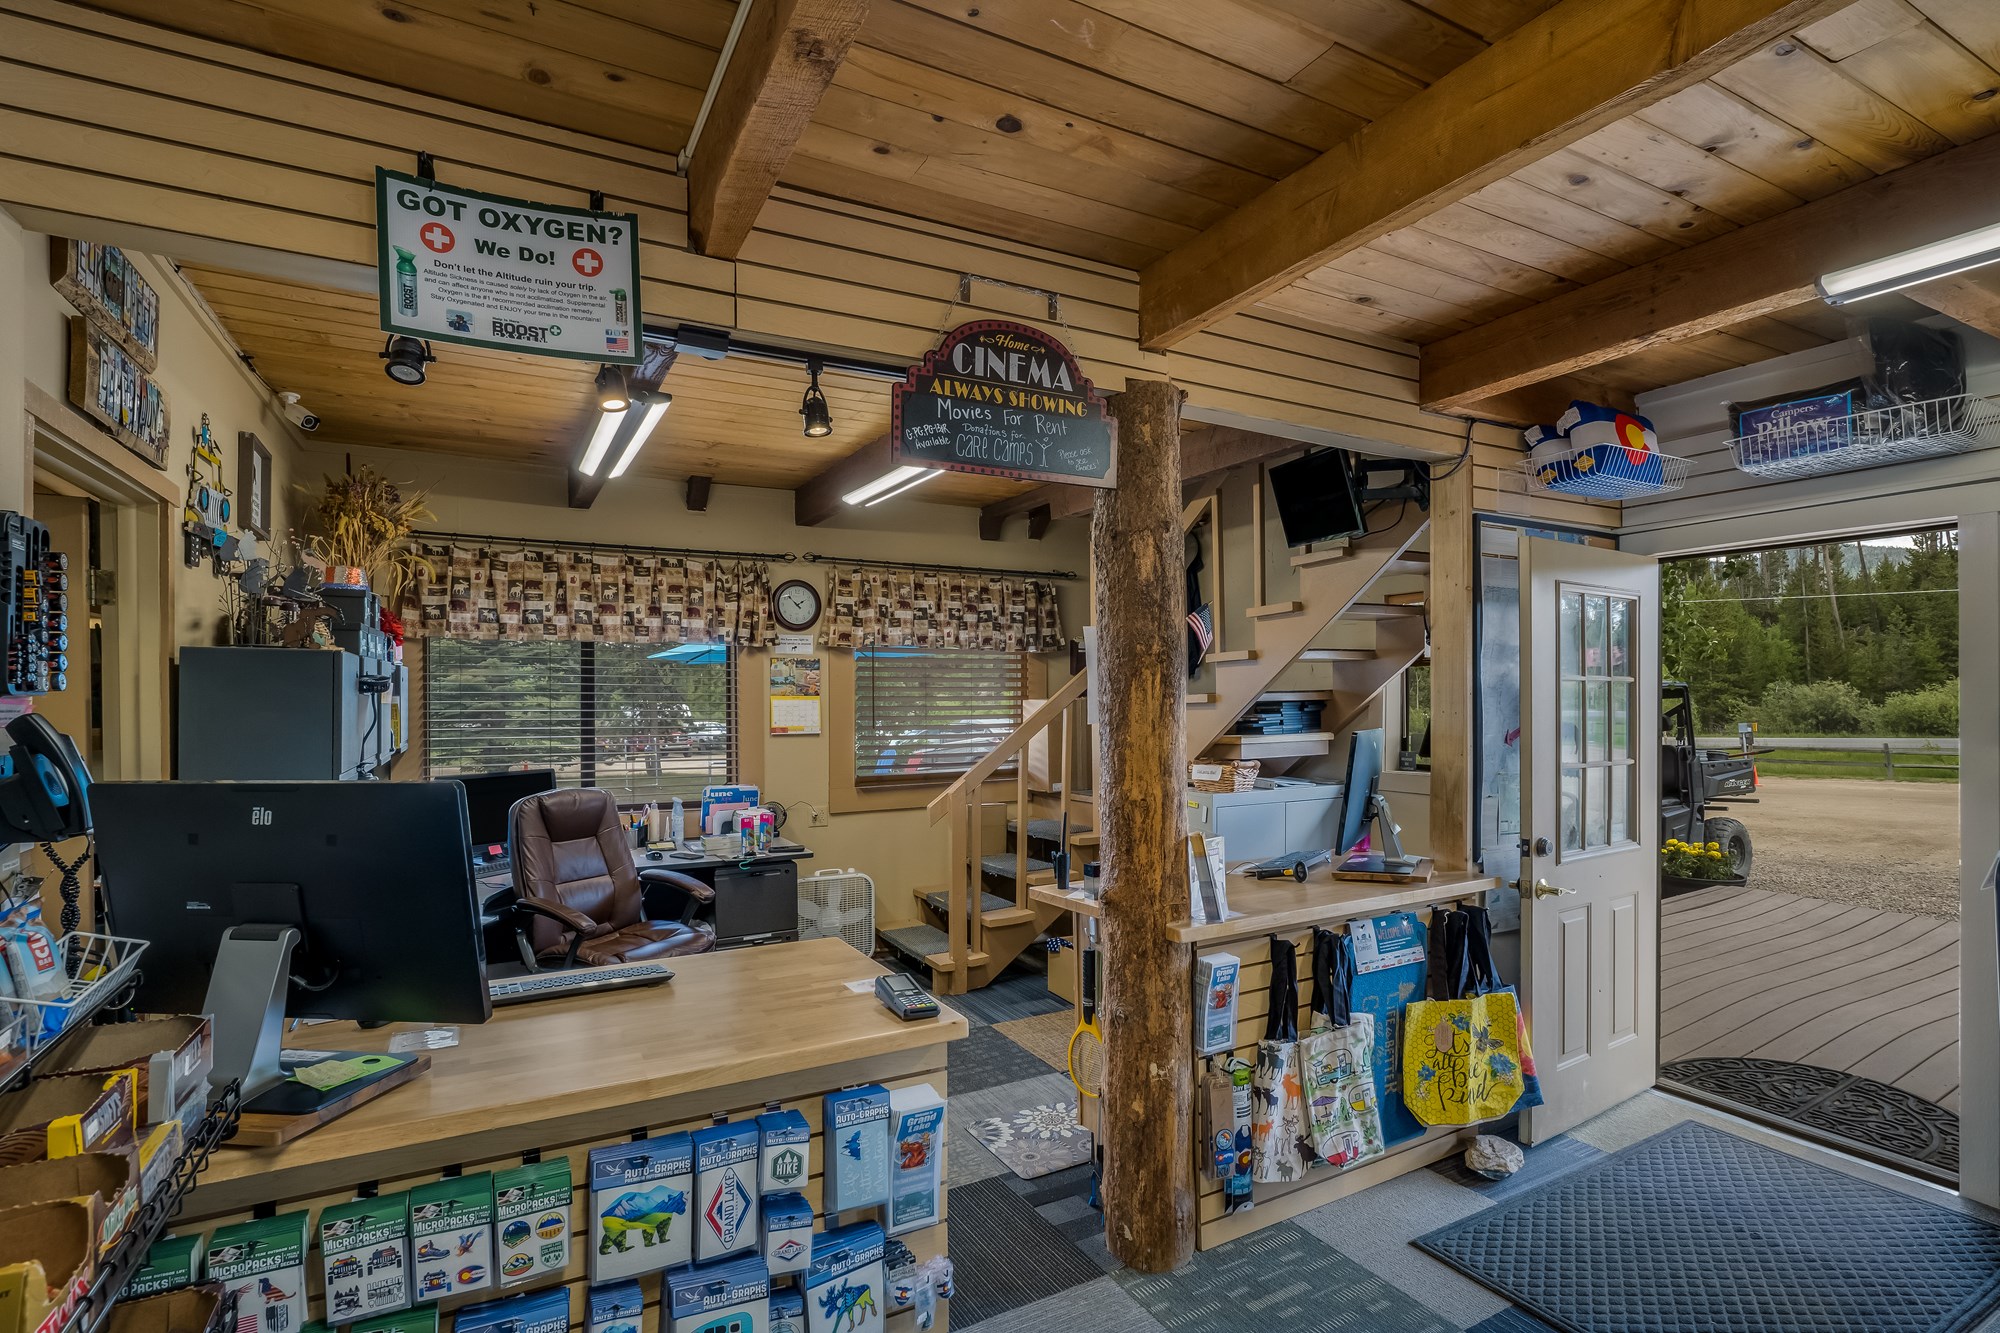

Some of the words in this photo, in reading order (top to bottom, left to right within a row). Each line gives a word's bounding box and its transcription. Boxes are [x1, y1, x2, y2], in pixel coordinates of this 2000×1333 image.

[397, 189, 466, 221] GOT
[479, 207, 623, 245] OXYGEN?
[474, 238, 510, 259] We
[519, 246, 555, 265] Do!
[423, 268, 448, 278] Altitude
[450, 273, 478, 284] Sickness
[486, 281, 509, 289] caused
[558, 290, 580, 298] Oxygen
[434, 259, 461, 271] Don't
[463, 265, 476, 274] let
[478, 268, 493, 277] the
[496, 271, 532, 283] Altitude
[535, 278, 553, 286] ruin
[555, 281, 576, 289] your
[578, 283, 597, 292] trip.
[430, 293, 445, 301] Stay
[447, 296, 485, 308] Oxygenated
[500, 304, 522, 312] ENJOY
[438, 287, 462, 296] Oxygen
[492, 297, 536, 308] recommended
[471, 286, 493, 294] anyone
[567, 299, 606, 308] Supplemental
[492, 320, 549, 341] BOOST
[996, 334, 1030, 352] Home
[952, 342, 1073, 392] CINEMA
[929, 378, 1003, 404] ALWAYS
[1009, 391, 1088, 418] SHOWING
[938, 397, 992, 421] Movies
[1004, 409, 1024, 426] For
[1034, 414, 1069, 436] Rent
[962, 423, 1007, 438] Donations
[1757, 415, 1832, 443] Pillow
[915, 436, 950, 449] Available
[703, 787, 733, 798] June
[1385, 1039, 1399, 1096] BETTER
[836, 1106, 889, 1124] AUTO-GRAPHS
[907, 1112, 937, 1127] Grand
[908, 1122, 931, 1133] Lake
[700, 1146, 758, 1167] AUTO-GRAPHS
[625, 1160, 691, 1179] AUTO-GRAPHS
[776, 1162, 799, 1176] HIKE
[725, 1173, 735, 1205] LAKE
[724, 1205, 735, 1244] GRAND
[773, 1247, 792, 1257] GRAND
[792, 1245, 806, 1255] LAKE
[831, 1245, 884, 1273] AUTO-GRAPHS
[703, 1284, 767, 1306] AUTO-GRAPHS
